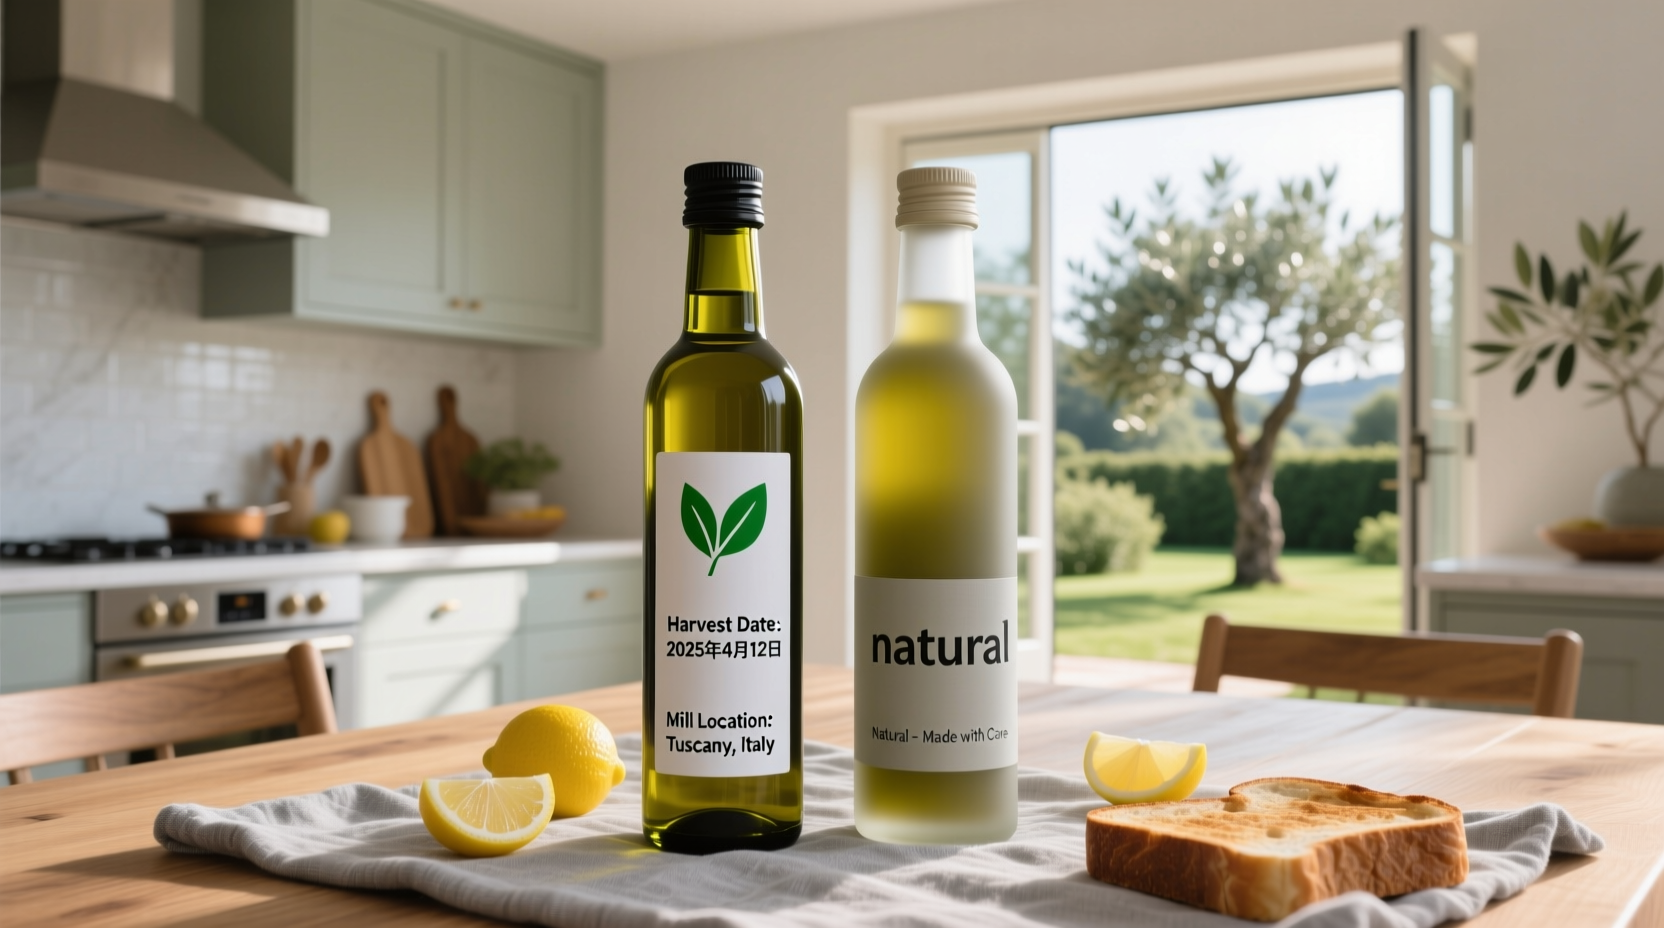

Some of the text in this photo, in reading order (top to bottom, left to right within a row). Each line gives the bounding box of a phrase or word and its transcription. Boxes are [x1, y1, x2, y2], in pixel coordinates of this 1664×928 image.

[667, 615, 782, 633] Harvest Date:
[666, 639, 782, 660] 2025年4月12日
[872, 619, 1009, 667] natural
[666, 711, 773, 730] Mill Location:
[872, 726, 909, 743] Natural
[922, 729, 958, 743] Made
[960, 727, 985, 743] with
[986, 726, 1009, 741] Care
[666, 735, 775, 758] Tuscany, Italy
